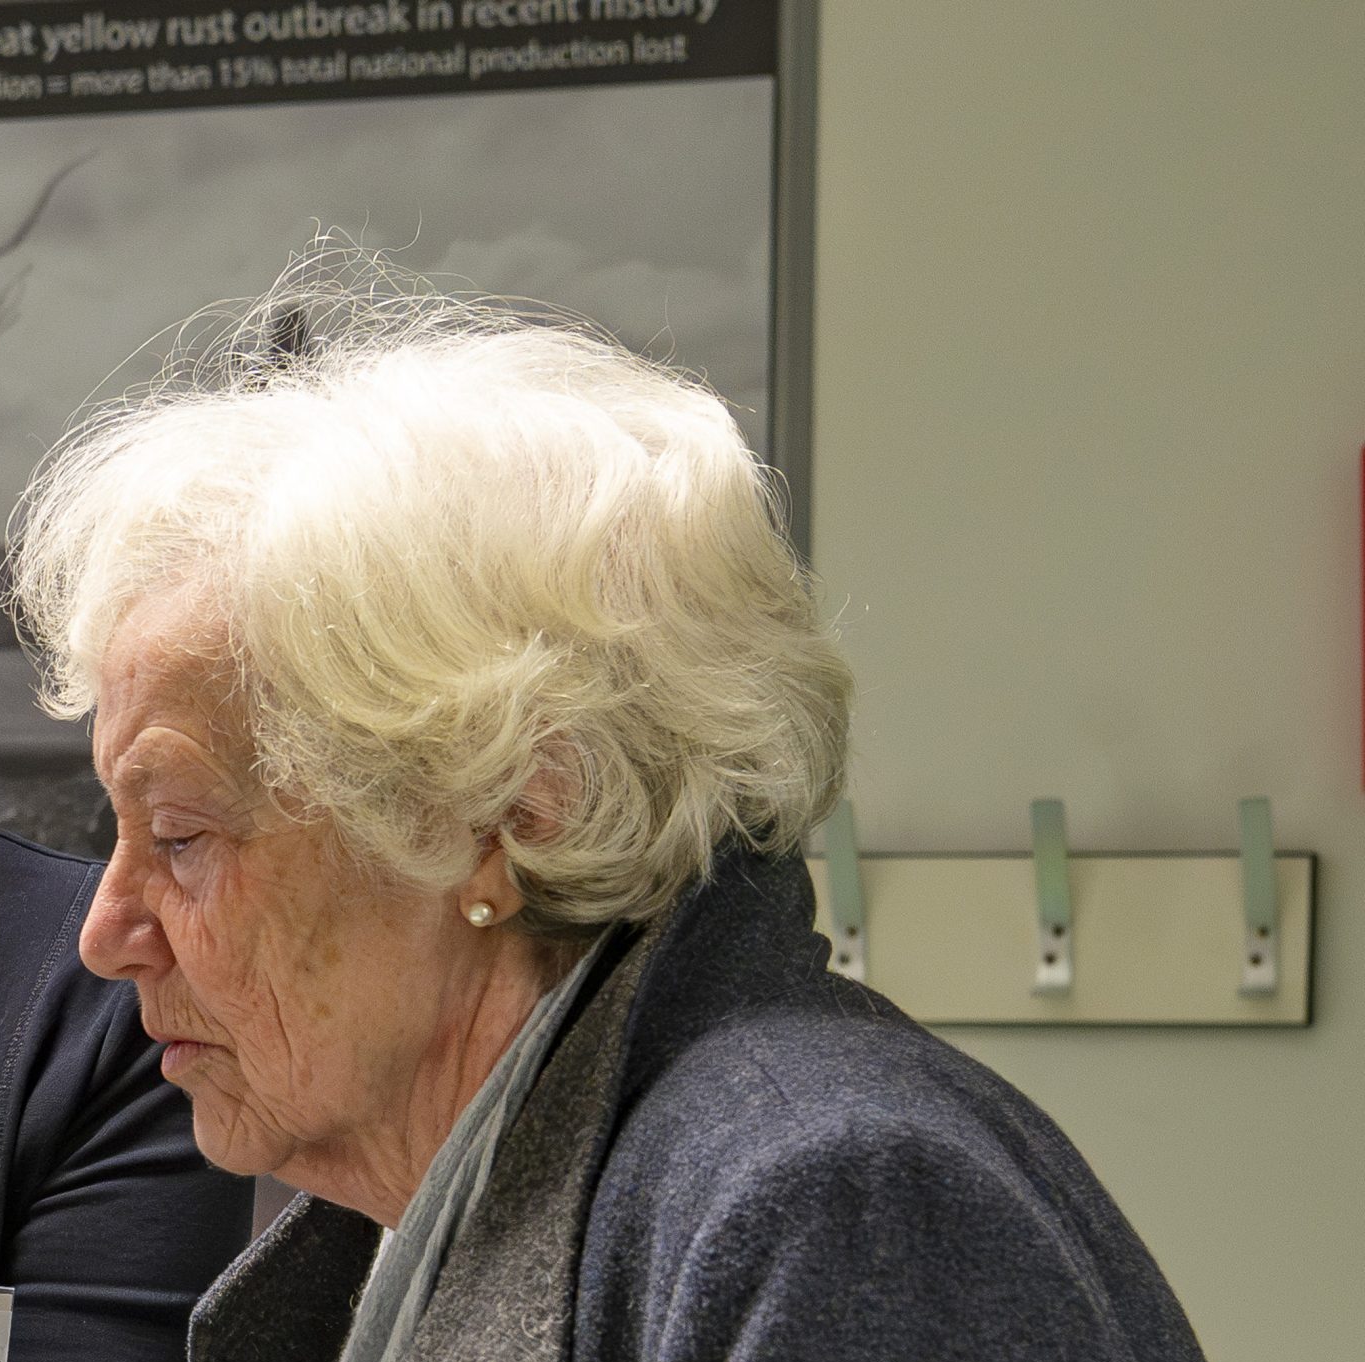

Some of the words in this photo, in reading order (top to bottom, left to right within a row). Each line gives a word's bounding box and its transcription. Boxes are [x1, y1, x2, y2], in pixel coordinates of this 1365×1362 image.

[41, 12, 161, 63] yellow
[168, 9, 237, 45] rust
[243, 0, 411, 42] outbreak
[416, 0, 454, 31] in
[461, 0, 580, 28] recent
[69, 68, 145, 97] more
[147, 59, 213, 92] than
[218, 56, 277, 88] 15%
[280, 49, 347, 84] total
[349, 42, 466, 80] national
[469, 36, 629, 81] production
[632, 31, 688, 64] lost
